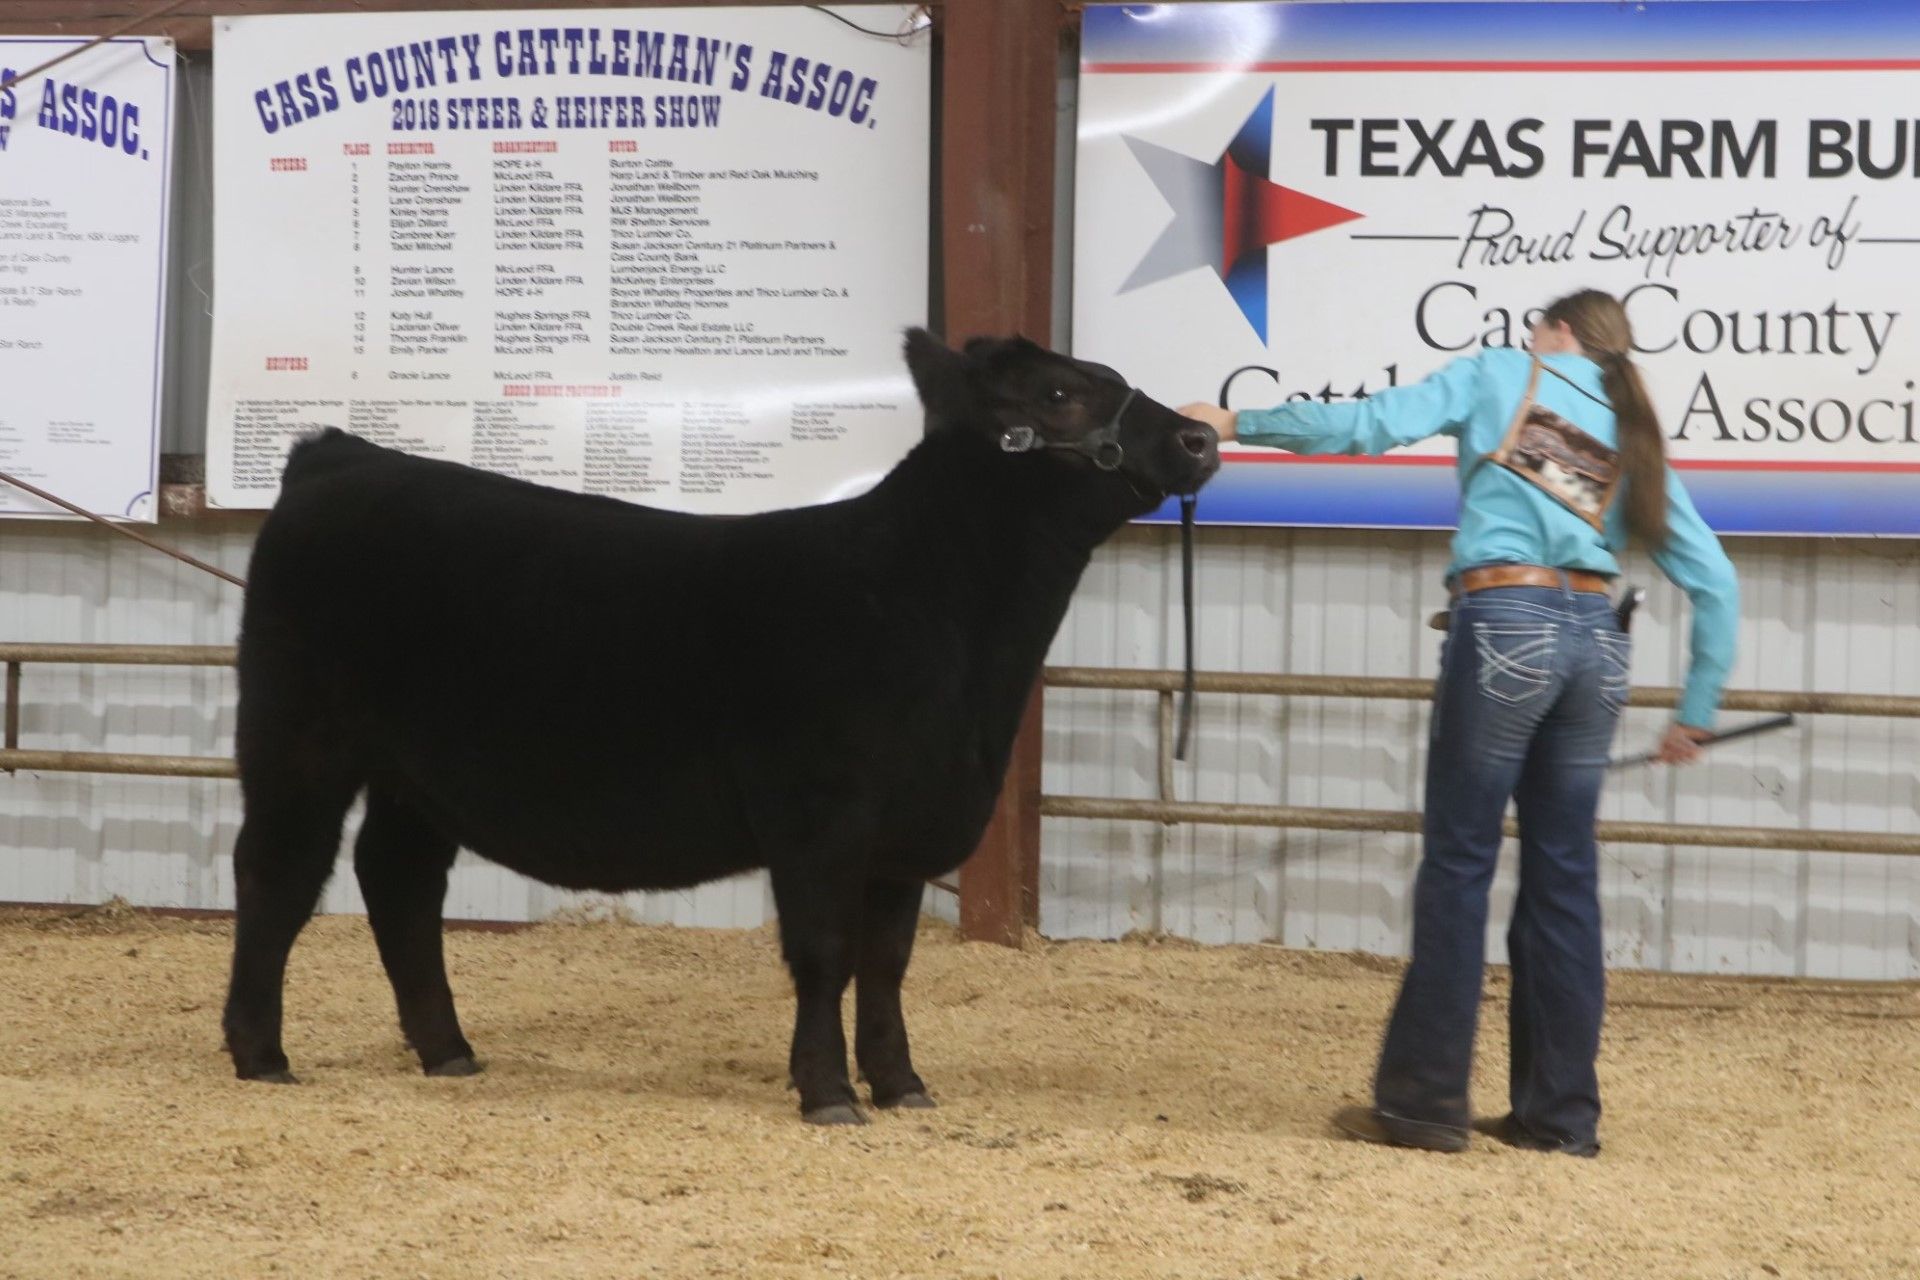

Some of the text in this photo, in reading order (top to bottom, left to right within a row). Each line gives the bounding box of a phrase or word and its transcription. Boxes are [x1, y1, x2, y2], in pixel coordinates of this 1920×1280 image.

[38, 79, 148, 161] ASSOC.
[253, 28, 878, 134] CASS COUNTY CATTLEMAN'S ASSOC.
[392, 95, 722, 130] 2018 STEER & HEIFER SHOW
[1310, 118, 1545, 178] TEXAS
[1573, 119, 1778, 178] FARM
[1457, 195, 1860, 278] Proud Supporter of
[1621, 283, 1901, 375] County
